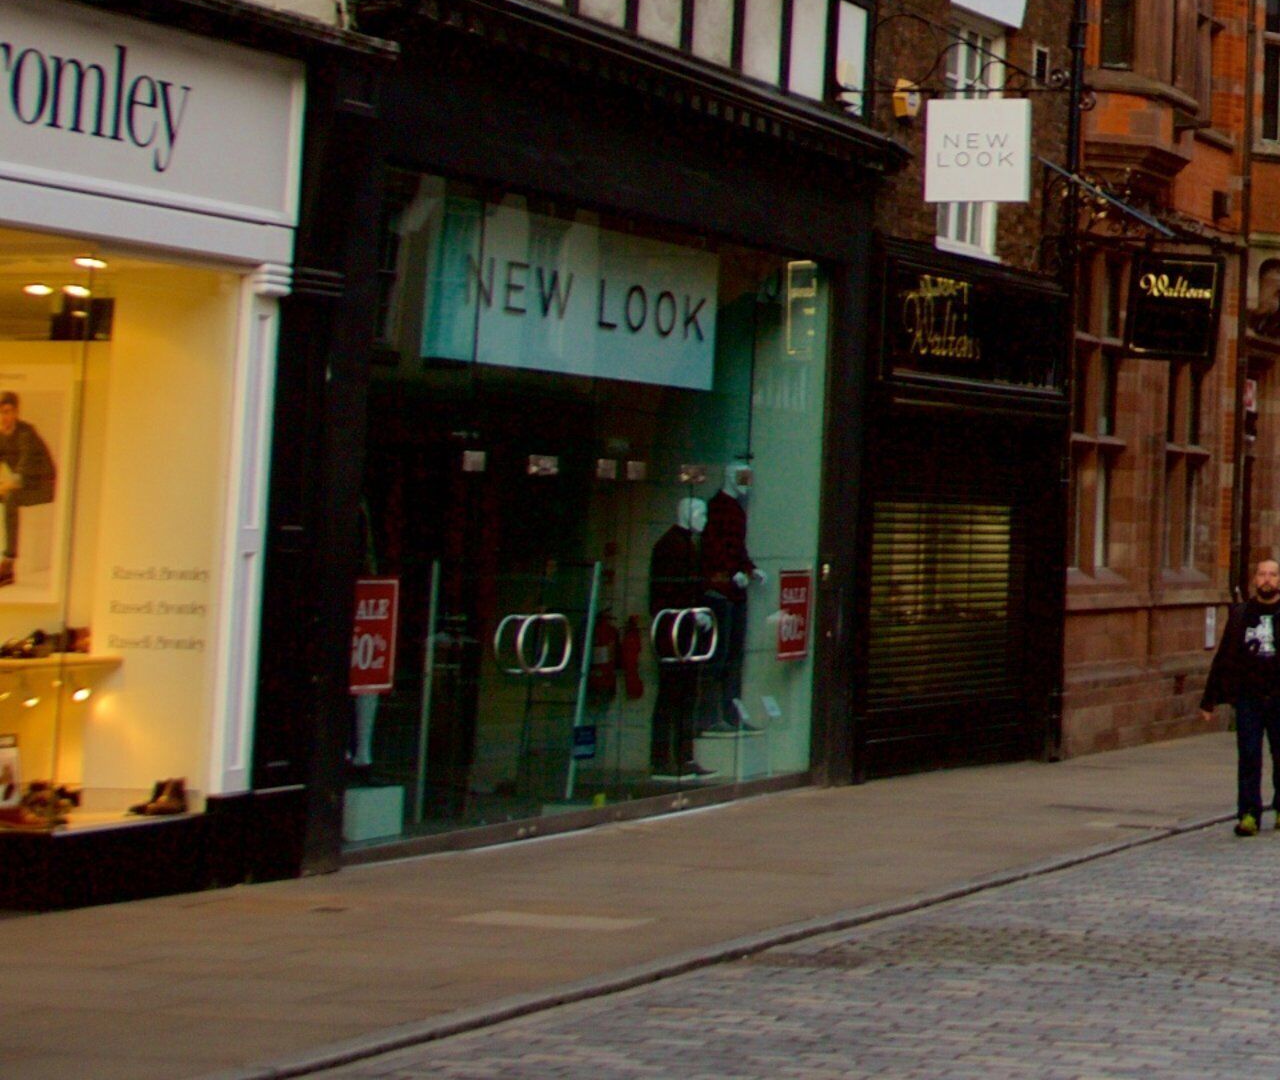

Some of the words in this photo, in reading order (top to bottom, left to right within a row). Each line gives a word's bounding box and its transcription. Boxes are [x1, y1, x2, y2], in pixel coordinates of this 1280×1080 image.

[943, 132, 1009, 149] NEW
[937, 151, 1014, 168] LOOK
[1139, 273, 1213, 299] Waltons
[465, 253, 575, 320] NEW
[597, 279, 706, 342] LOOK
